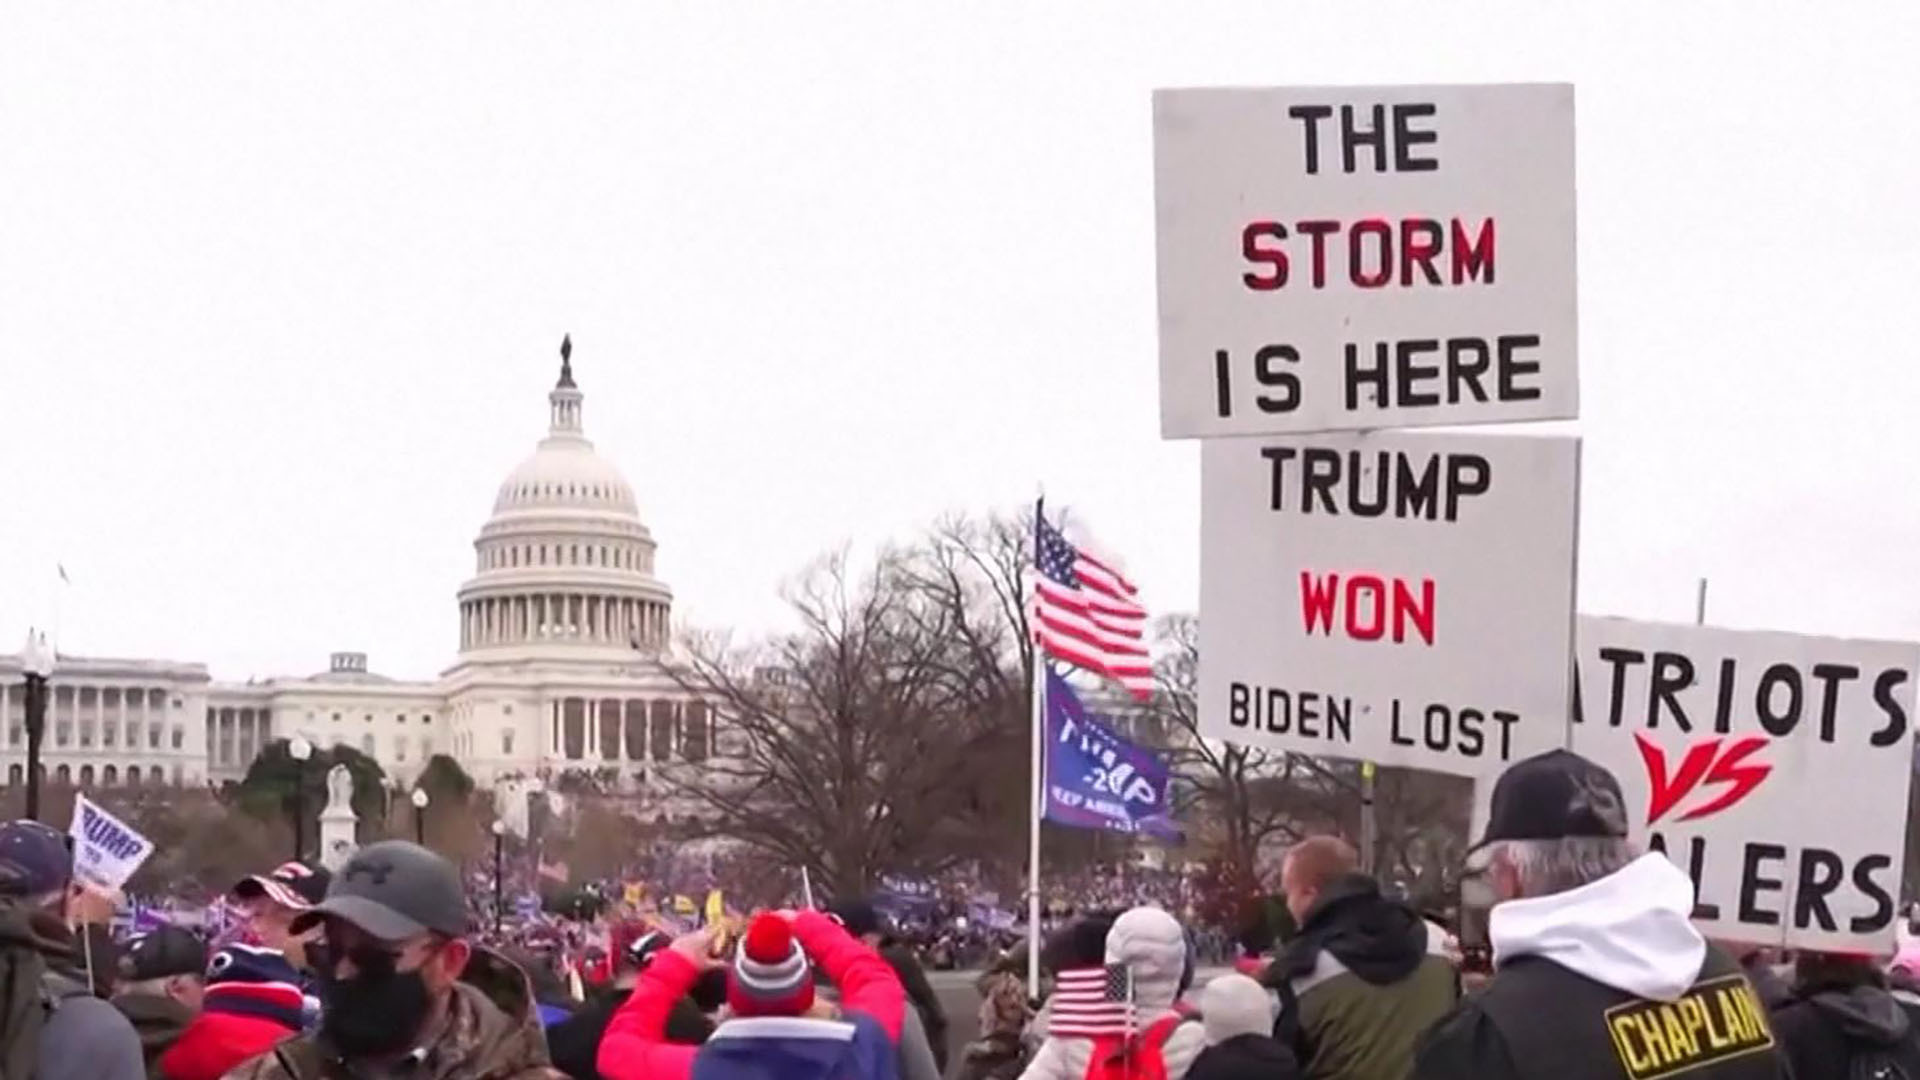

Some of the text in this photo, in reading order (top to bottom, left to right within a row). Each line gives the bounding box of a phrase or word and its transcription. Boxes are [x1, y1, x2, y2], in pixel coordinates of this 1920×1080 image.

[1289, 103, 1438, 174] THE
[1242, 217, 1495, 290] STORM
[1216, 335, 1541, 417] IS HERE
[1261, 447, 1491, 522] TRUMP
[1301, 571, 1435, 646] WON
[1230, 682, 1520, 760] BIDEN LOST
[1634, 733, 1772, 827] VS
[1650, 833, 1894, 934] LERS
[1613, 987, 1766, 1071] CHAPLAIN
